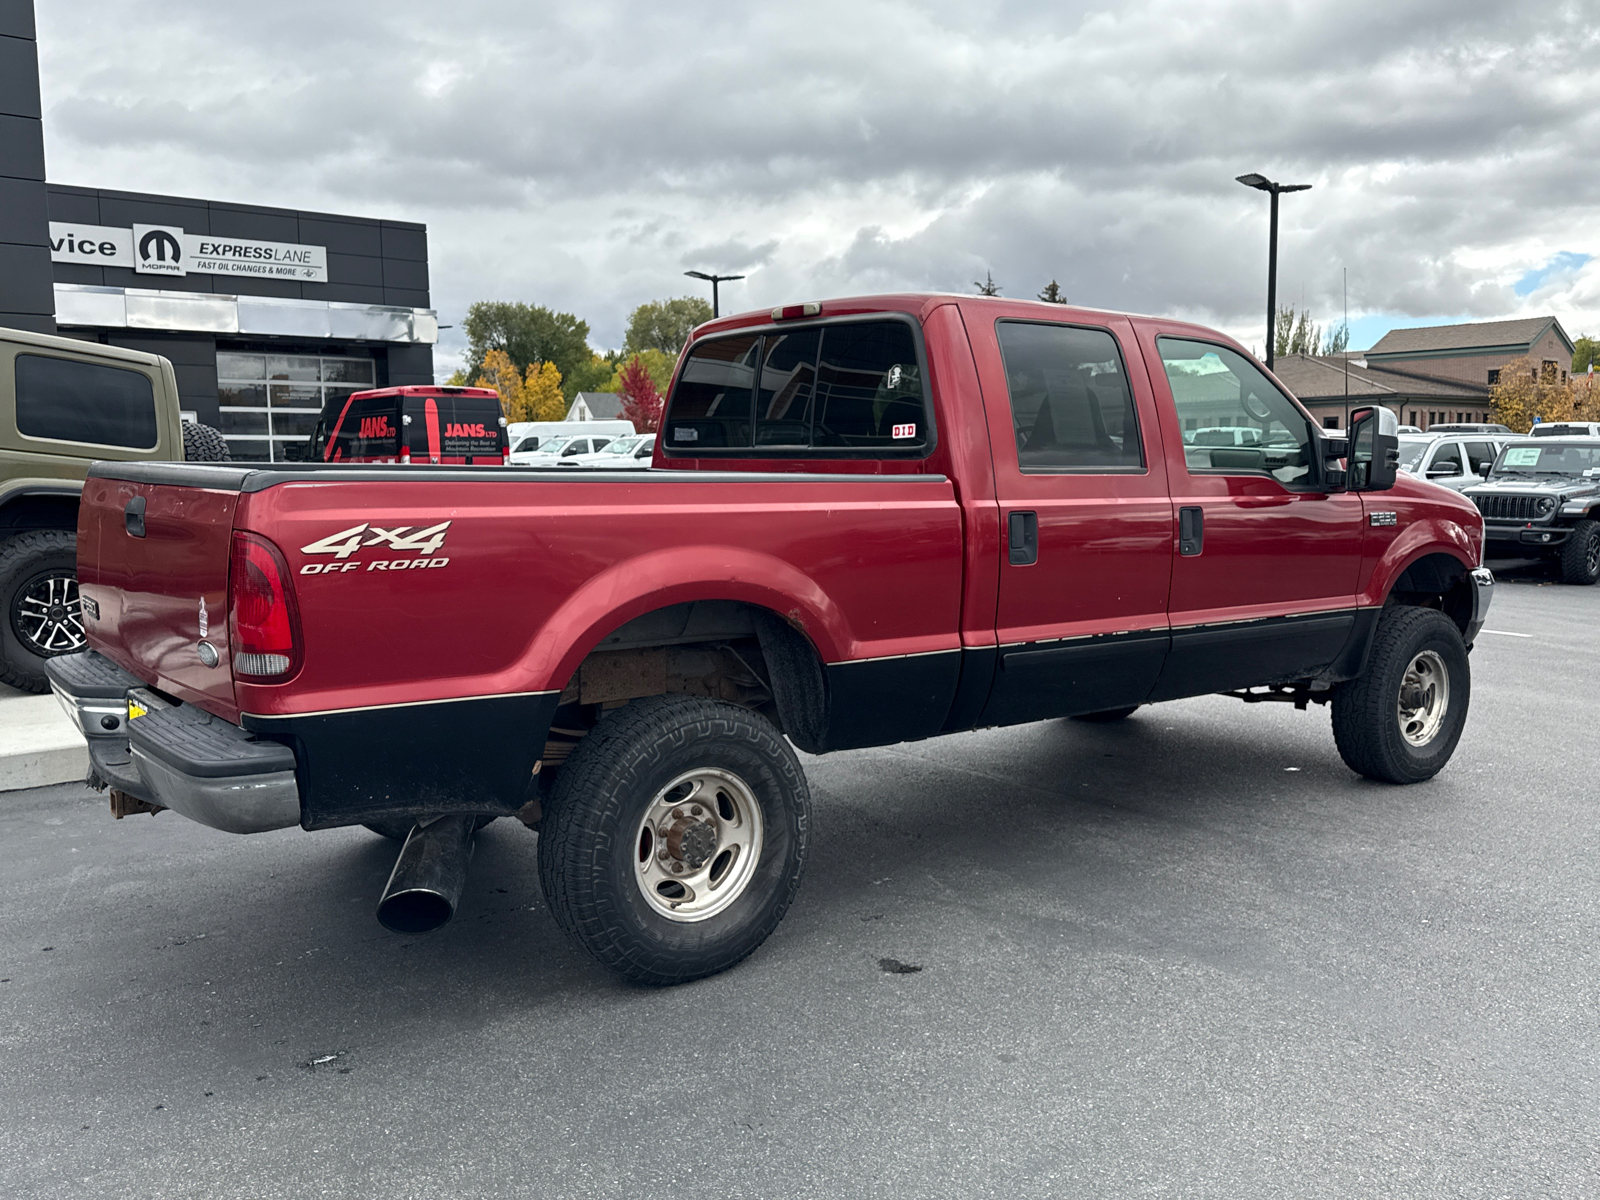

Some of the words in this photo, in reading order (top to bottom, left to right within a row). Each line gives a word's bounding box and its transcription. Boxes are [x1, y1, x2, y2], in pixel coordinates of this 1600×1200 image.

[49, 233, 117, 256] vice
[199, 242, 312, 263] EXPRESSLANE
[142, 263, 181, 271] MOPAR
[197, 261, 217, 270] FAST
[218, 262, 230, 271] OIL
[232, 263, 267, 274] CHANGES
[268, 266, 274, 274] &
[276, 267, 297, 276] MORE
[359, 416, 388, 438] JANS
[386, 427, 396, 437] LTD
[444, 423, 486, 438] JANS
[300, 562, 362, 574] OFF
[367, 558, 450, 571] ROAD
